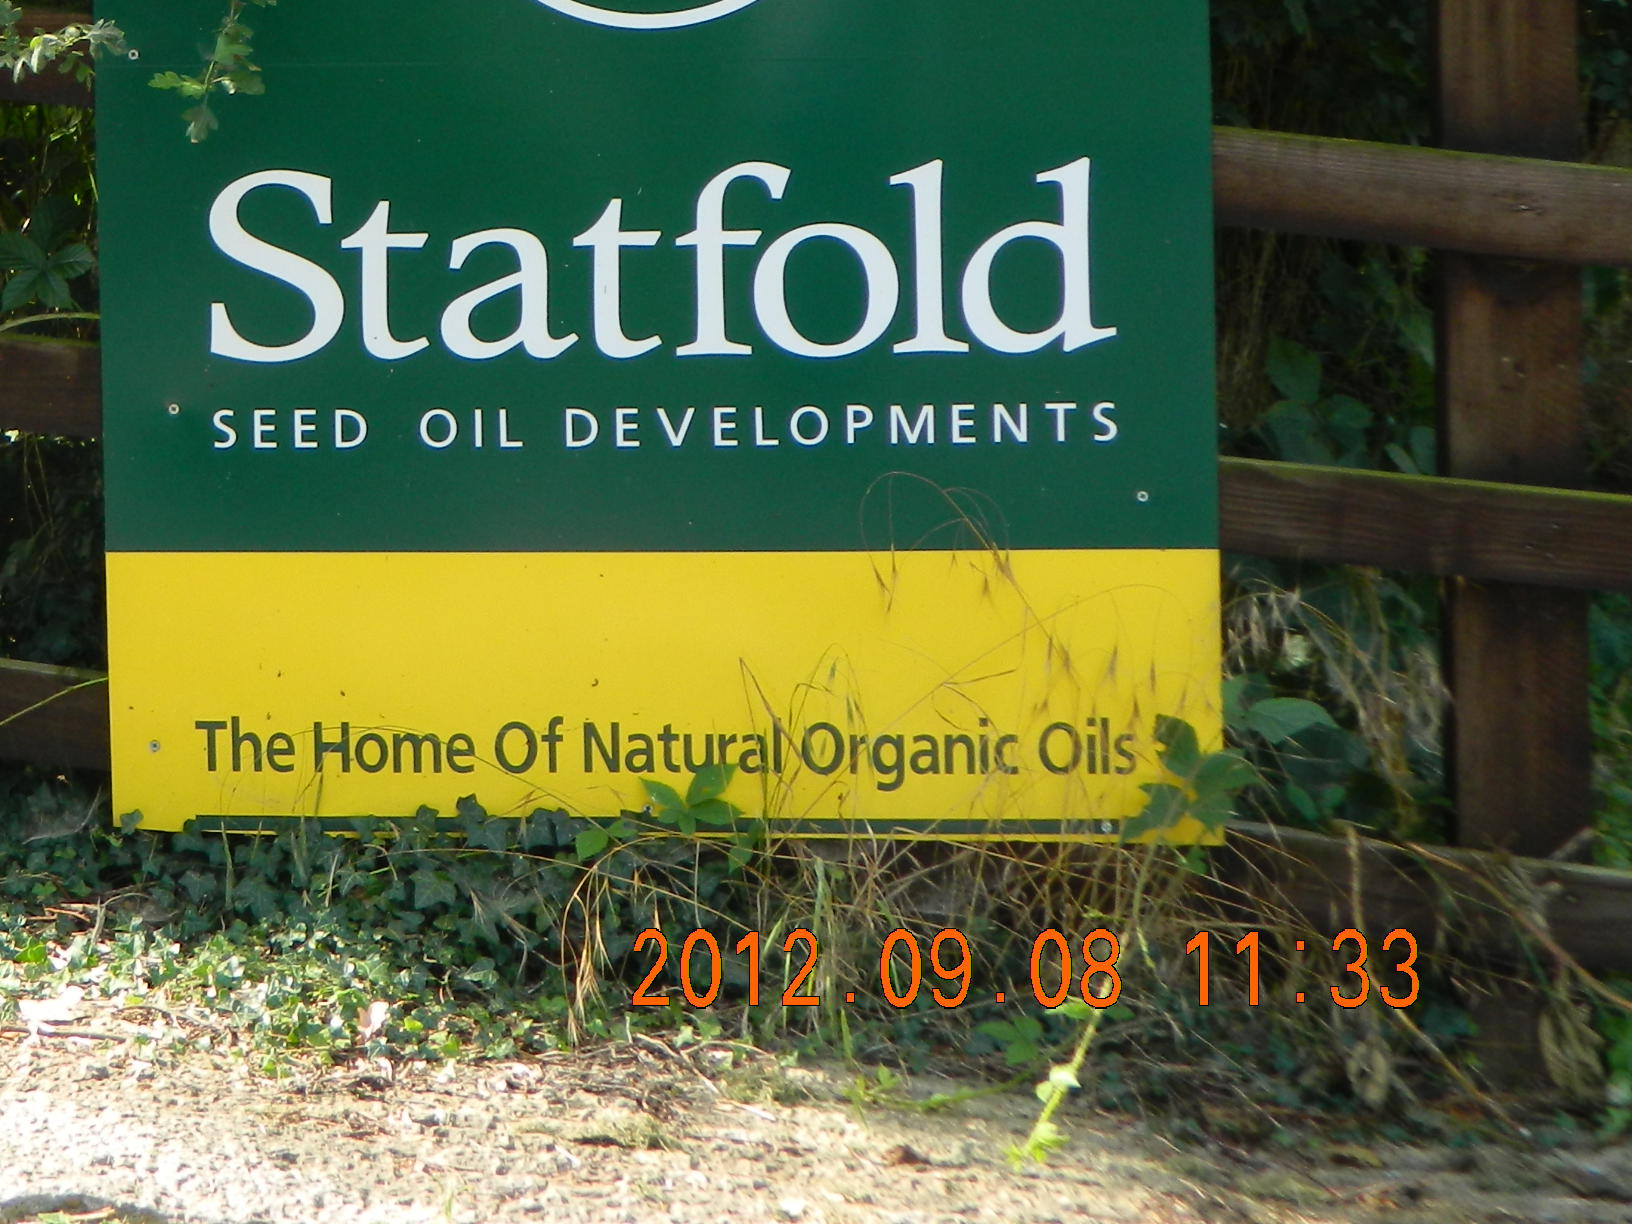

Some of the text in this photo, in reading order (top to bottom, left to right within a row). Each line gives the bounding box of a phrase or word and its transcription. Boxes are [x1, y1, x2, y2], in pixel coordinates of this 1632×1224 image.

[208, 156, 1118, 363] Statfold
[213, 401, 1119, 449] SEED OIL DEVELOPMENTS
[194, 715, 1137, 792] The Home Of Natural Organic Oils
